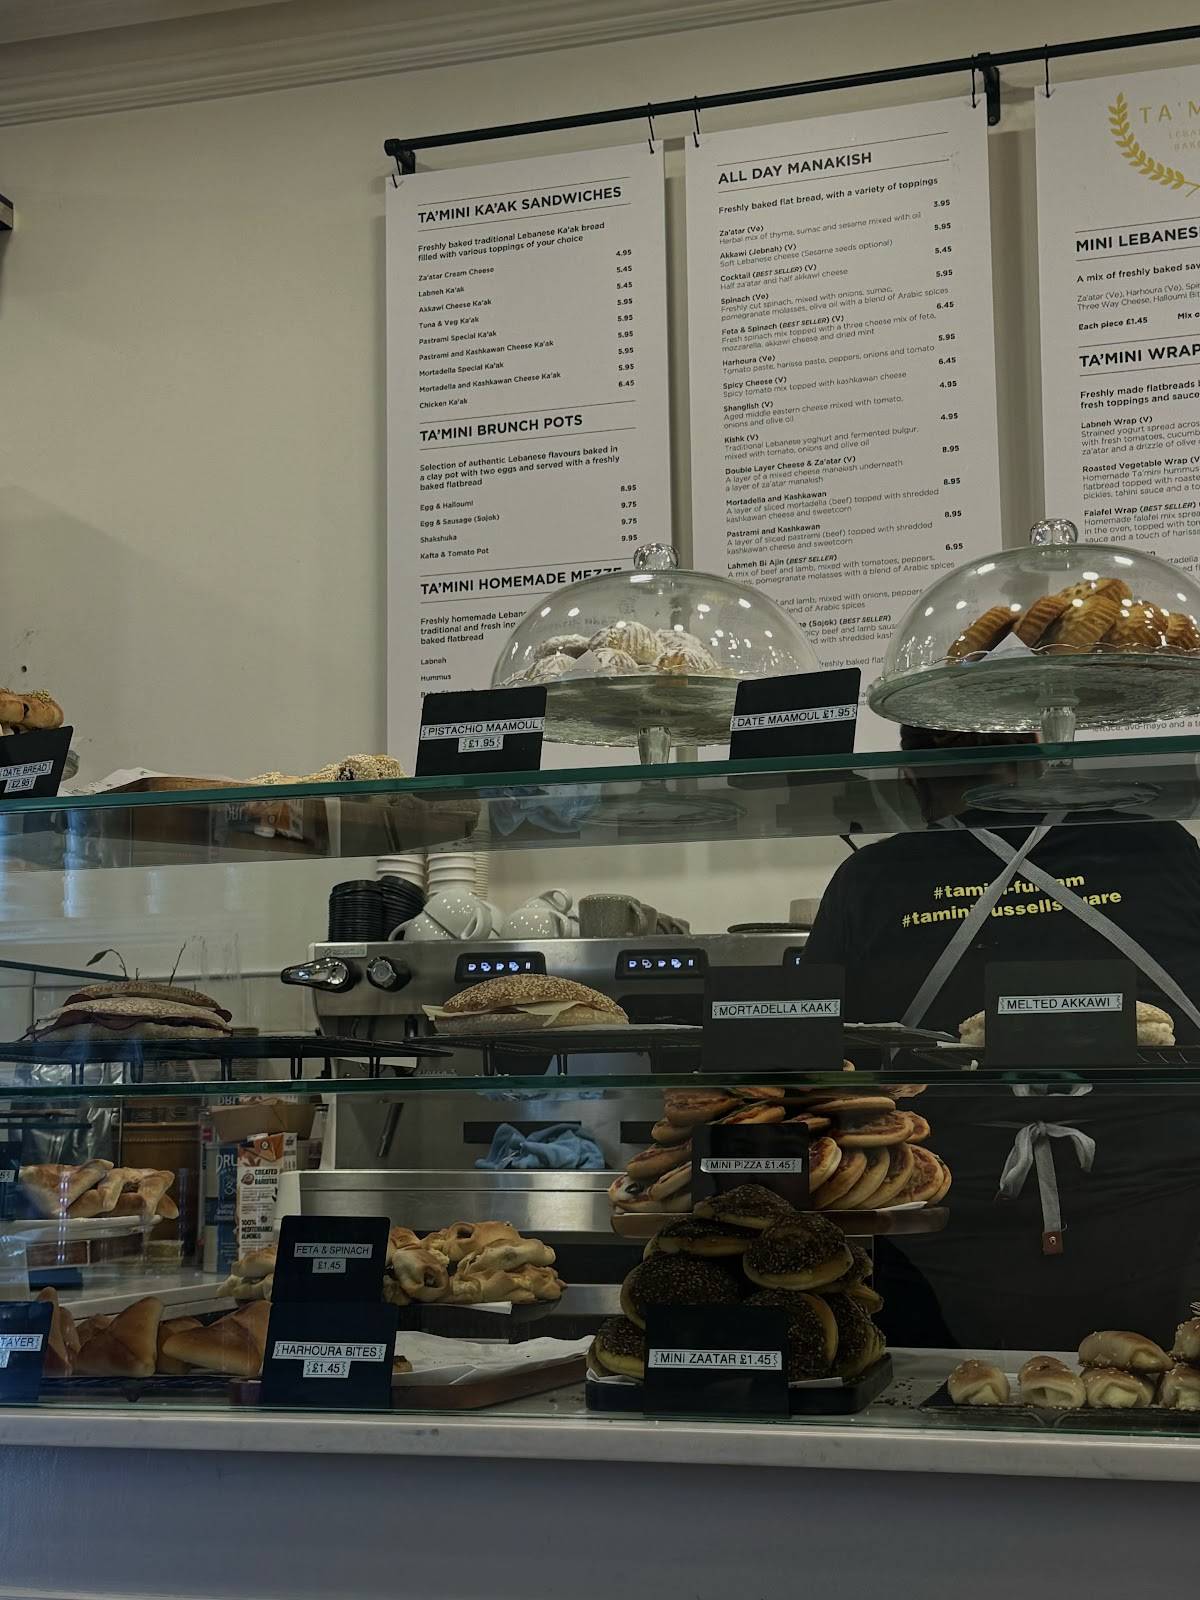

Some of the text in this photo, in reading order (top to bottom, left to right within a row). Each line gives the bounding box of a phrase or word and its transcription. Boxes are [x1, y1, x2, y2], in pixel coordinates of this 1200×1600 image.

[719, 152, 872, 185] ALL DAY MANAKISH
[718, 203, 749, 215] Freshly
[751, 200, 778, 210] baked
[779, 197, 795, 206] flat
[796, 193, 824, 204] bread,
[825, 190, 845, 199] with
[854, 185, 885, 196] variety
[887, 182, 897, 191] of
[898, 178, 938, 190] toppings
[418, 186, 621, 224] TA'MINI KA'AK SANDWICHES
[933, 199, 951, 208] 3.95
[934, 222, 951, 231] 5.95
[418, 242, 447, 253] Freshly
[448, 239, 473, 248] baked
[474, 234, 516, 245] traditional
[517, 229, 556, 239] Lebanese
[581, 222, 605, 231] bread
[1076, 226, 1200, 252] MINI LEBANES
[418, 235, 584, 262] filled with various toppings of your choice
[616, 249, 632, 257] 4.95
[934, 246, 952, 254] 5.45
[444, 270, 467, 278] Cream
[468, 266, 495, 275] Cheese
[616, 265, 633, 273] 5.45
[935, 269, 953, 278] 5.95
[1077, 263, 1183, 283] A mix of freshly baked
[616, 281, 633, 290] 5.45
[418, 289, 444, 297] Labneh
[617, 298, 633, 306] 5.95
[721, 293, 769, 305] Spinach (Ve)
[936, 301, 955, 309] 6.45
[617, 314, 634, 322] 5.95
[419, 321, 436, 329] Tuna
[444, 319, 459, 328] Veg
[1078, 317, 1148, 331] Each piece £1.45
[617, 330, 634, 339] 5.95
[938, 333, 956, 341] 5.95
[618, 347, 634, 355] 5.95
[722, 355, 776, 366] Harhoura (Ve)
[938, 357, 957, 365] 6.45
[1079, 349, 1142, 367] TA'MINI
[618, 363, 635, 371] 5.95
[618, 379, 635, 388] 6.45
[1080, 381, 1196, 400] Freshly made flatbreads
[419, 400, 447, 409] Chicken
[1080, 393, 1170, 409] fresh toppings and
[723, 401, 774, 413] Shanglish (V)
[1081, 416, 1153, 429] Labneh Wrap (V)
[419, 414, 583, 442] TA'MINI BRUNCH POTS
[942, 445, 960, 453] 8.95
[420, 445, 618, 471] Selection of authentic Lebanese flavours baked in
[1082, 457, 1188, 473] Roasted Vegetable Wrap
[420, 478, 483, 491] baked flatbread
[943, 477, 961, 486] 8.95
[620, 484, 637, 492] 8.95
[726, 491, 827, 506] Mortadella and Kashkawan
[621, 501, 637, 509] 9.75
[944, 510, 962, 518] 8.95
[621, 517, 638, 525] 9.75
[420, 534, 457, 543] Shakshuka
[621, 534, 638, 542] 9.95
[945, 542, 964, 551] 6.95
[420, 572, 566, 595] TA'MINI HOMEMADE
[420, 633, 484, 645] baked flatbread
[420, 657, 447, 665] Labneh
[737, 708, 850, 727] DATE MAAMOUL £1.95
[428, 721, 538, 736] PISTACHIO MAAMOUL
[468, 739, 495, 748] £1.95
[2, 767, 21, 777] DATE
[1007, 997, 1110, 1010] MELTED AKKAWI
[719, 1002, 832, 1016] MORTADELLA KAAK
[710, 1160, 790, 1169] MINI PIZZA £1.45
[296, 1246, 369, 1255] FETA & SPINACH
[318, 1261, 340, 1270] £1.45
[281, 1345, 377, 1357] HARHOURA BITES
[660, 1353, 771, 1365] MINI ZAATAR £1.45
[312, 1363, 340, 1374] £1.45
